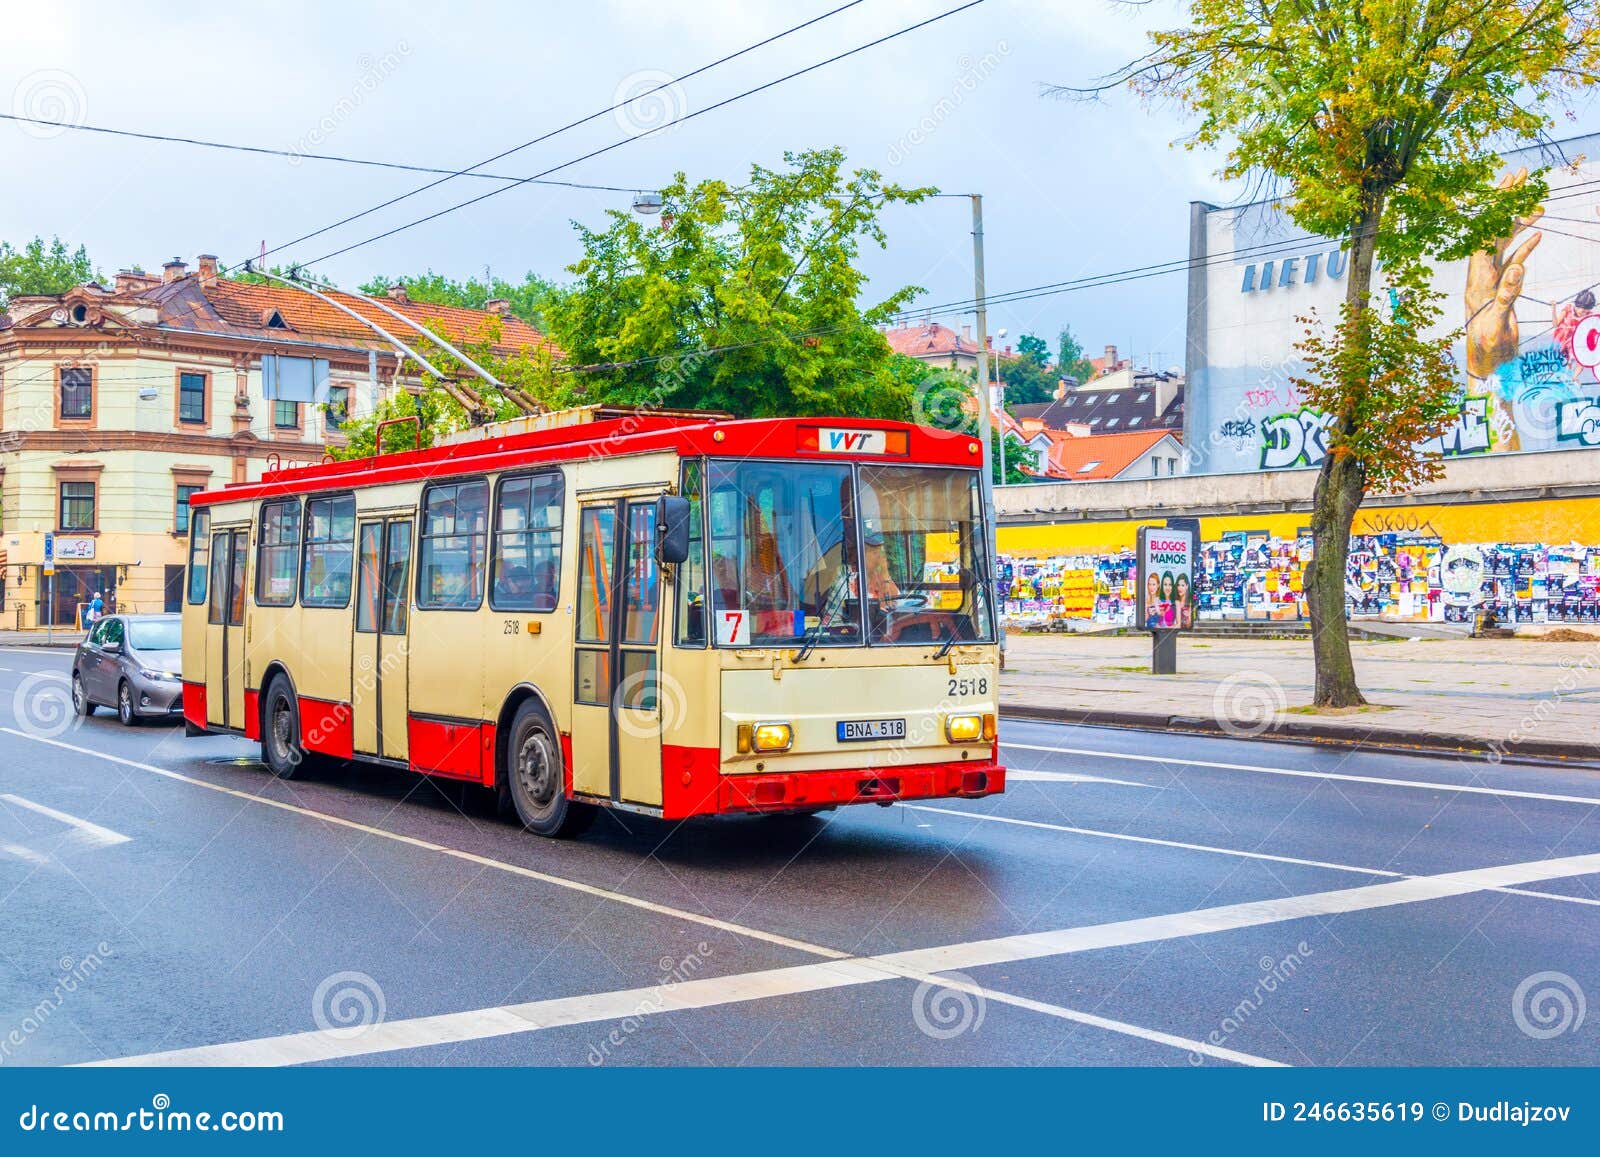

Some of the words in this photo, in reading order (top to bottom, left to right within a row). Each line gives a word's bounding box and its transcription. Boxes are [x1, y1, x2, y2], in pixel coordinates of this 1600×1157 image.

[1242, 249, 1382, 293] LIETU
[830, 432, 872, 450] VVT
[1150, 540, 1187, 552] BLOGOS
[1150, 553, 1187, 564] MAMOS
[503, 620, 520, 635] 2518
[725, 613, 742, 643] 7
[948, 679, 988, 696] 2518
[846, 722, 873, 738] BNA
[880, 721, 903, 736] 518
